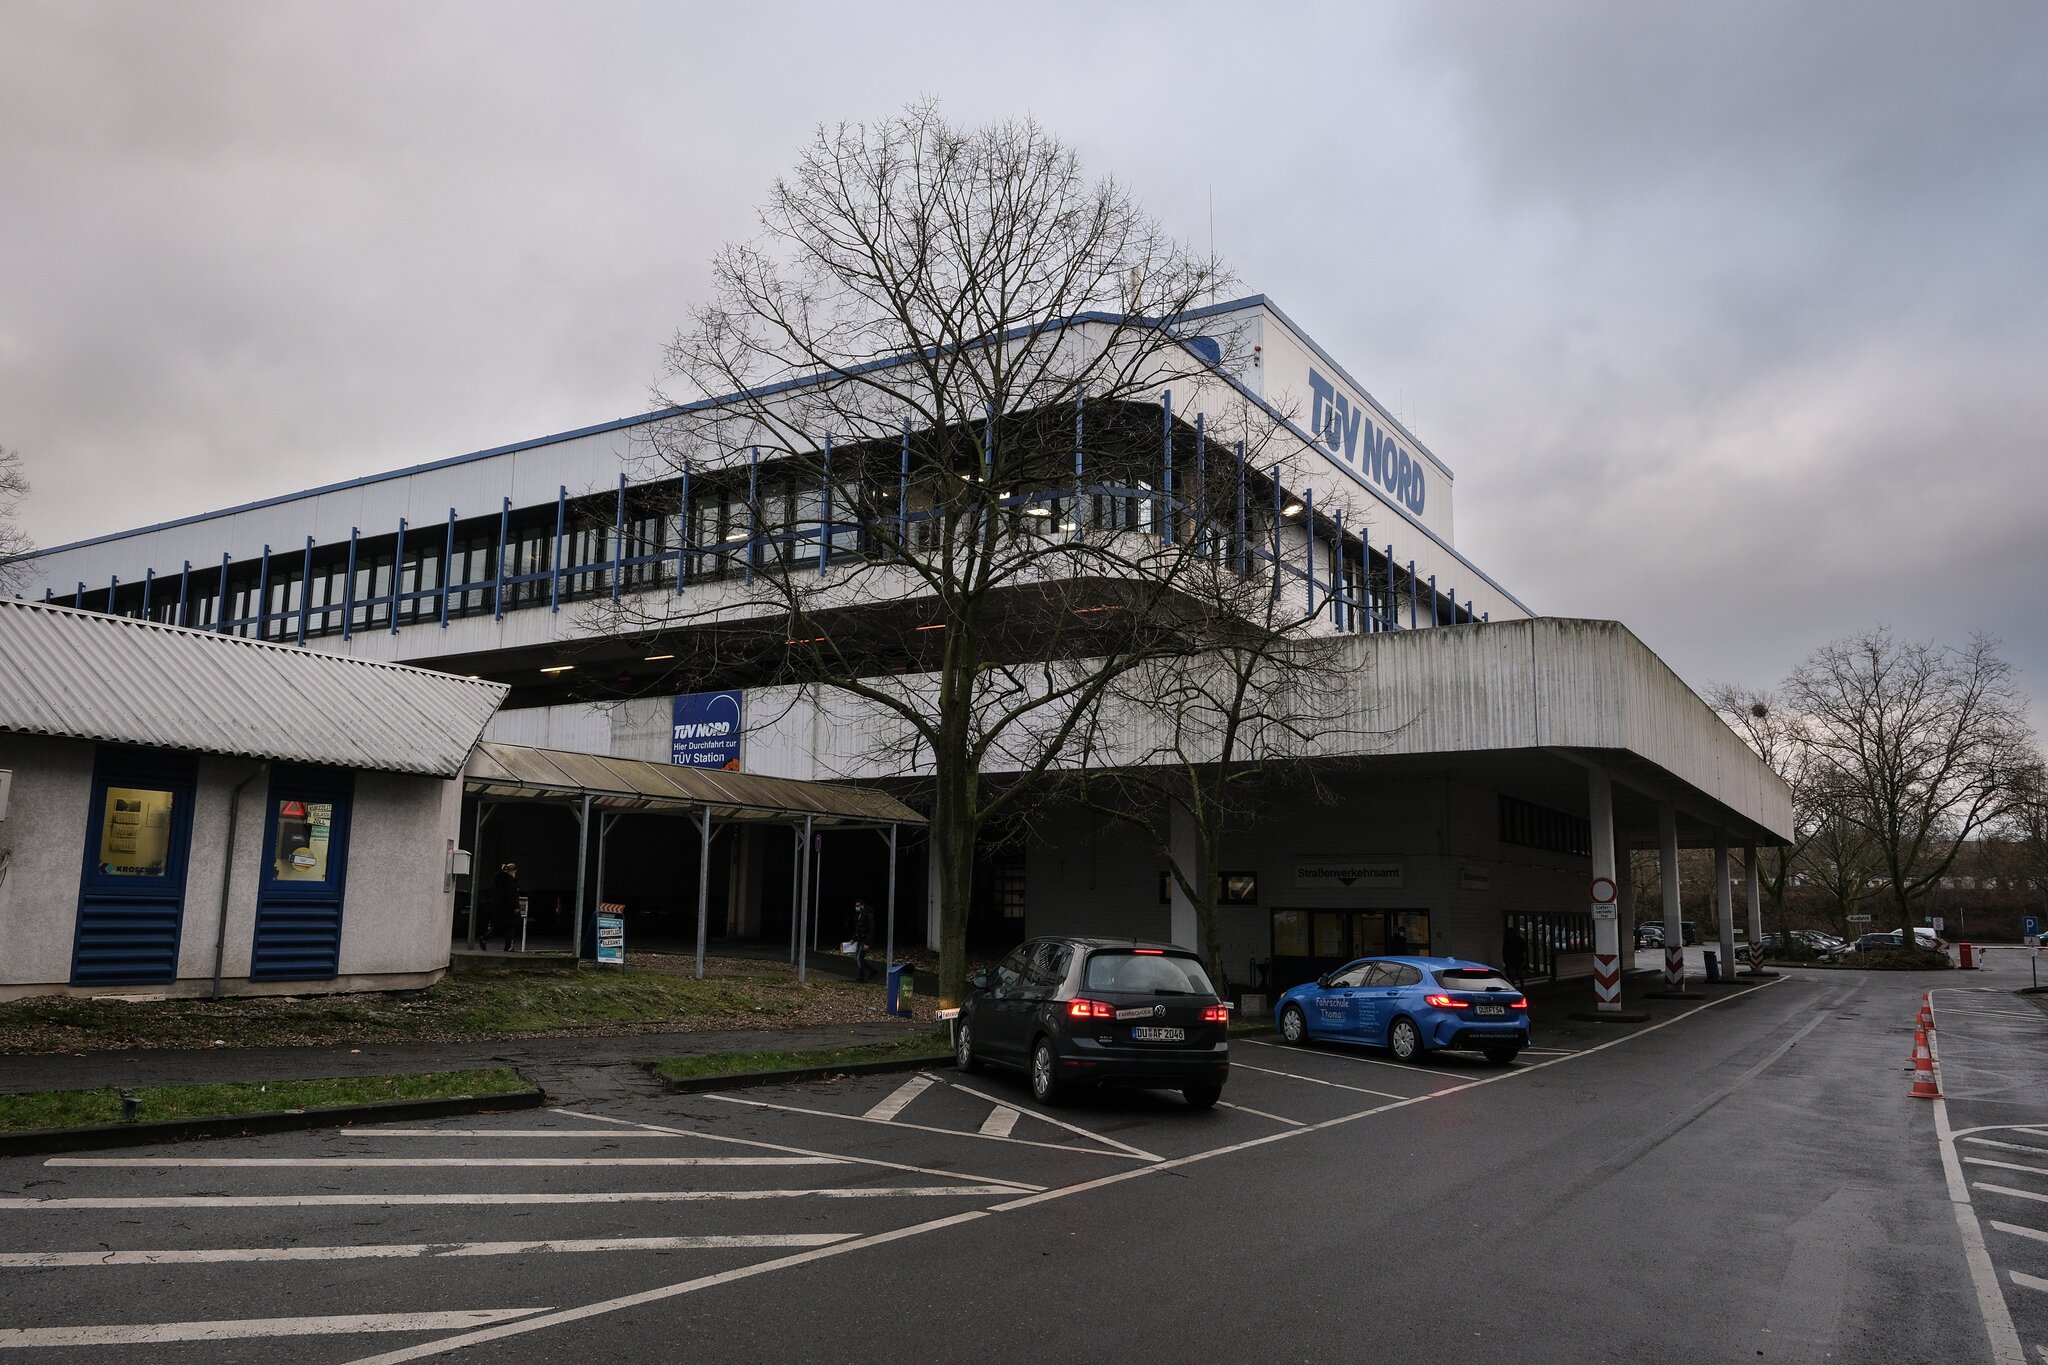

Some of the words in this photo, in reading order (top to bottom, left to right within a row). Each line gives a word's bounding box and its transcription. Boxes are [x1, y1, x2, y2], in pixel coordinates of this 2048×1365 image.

[1309, 367, 1361, 463] TÜV
[1362, 417, 1425, 516] NORD
[674, 724, 697, 739] TÜV
[696, 722, 730, 737] NORD
[689, 741, 724, 749] Durchfahrt
[673, 752, 691, 764] TÜV
[693, 752, 724, 763] Station
[1298, 868, 1400, 878] Straßenverkehrsamt
[2026, 919, 2034, 933] P
[1315, 997, 1349, 1008] Fahrschule
[1118, 1009, 1152, 1017] FAHRSCHULE
[1137, 1028, 1148, 1038] DU
[1153, 1028, 1162, 1038] AF
[1164, 1028, 1184, 1039] 2046
